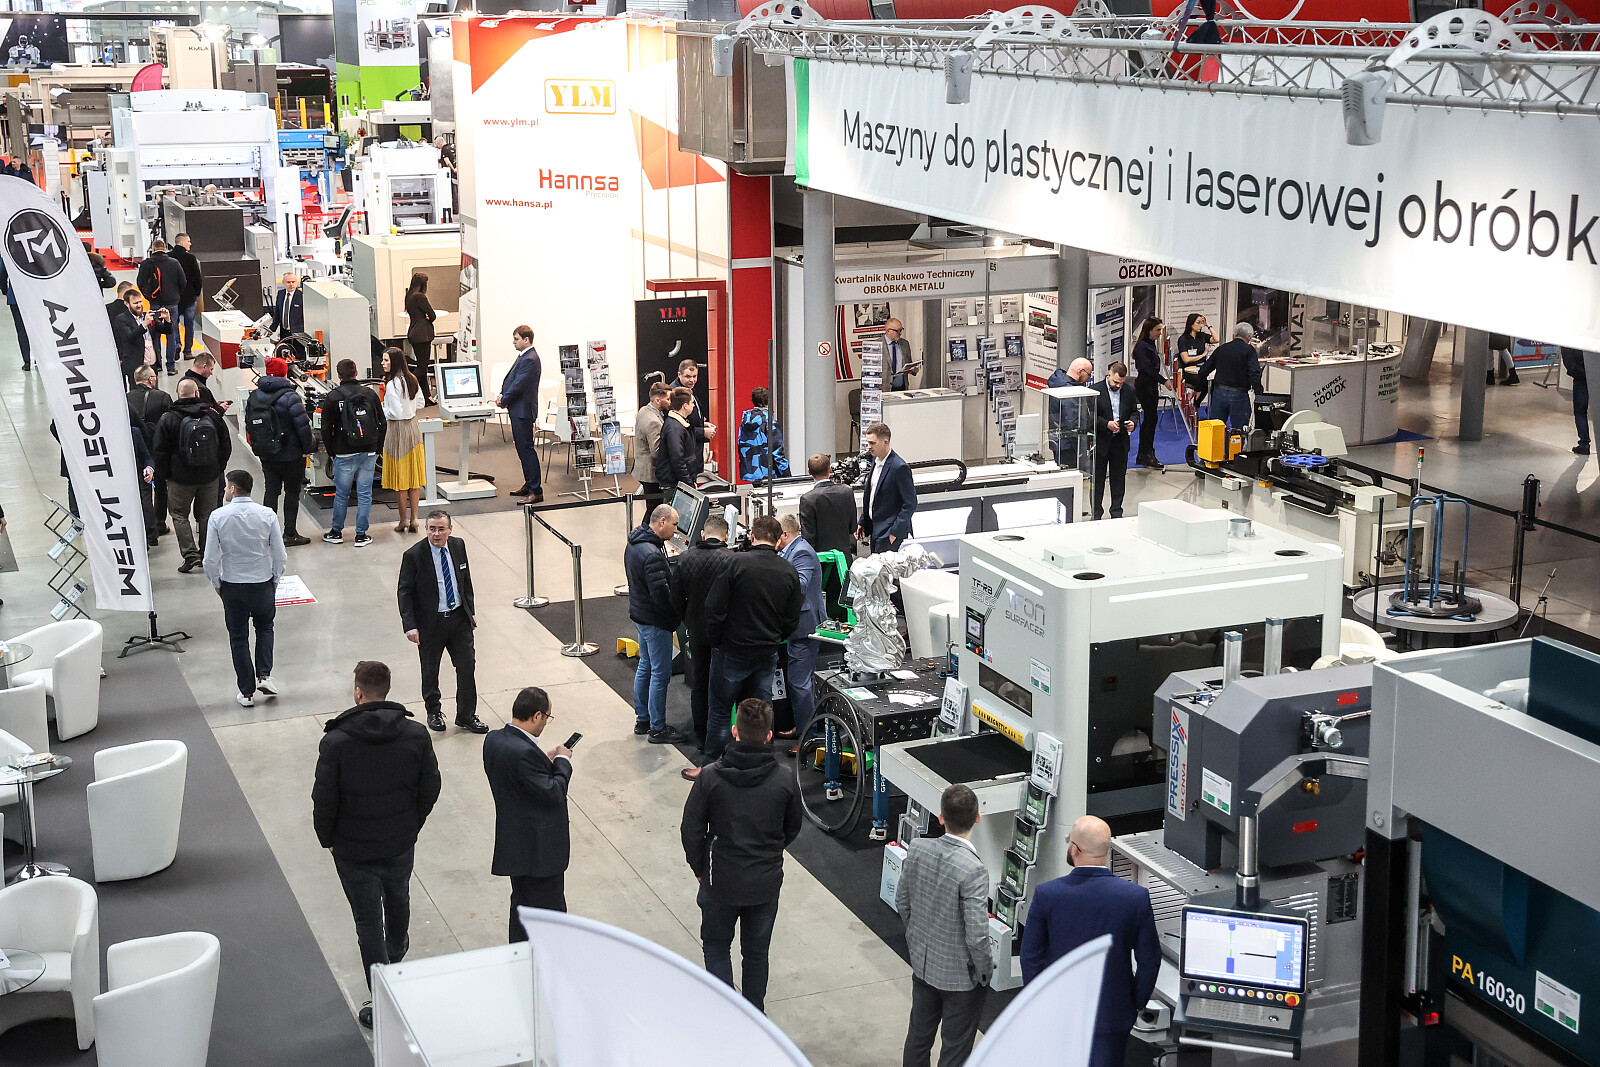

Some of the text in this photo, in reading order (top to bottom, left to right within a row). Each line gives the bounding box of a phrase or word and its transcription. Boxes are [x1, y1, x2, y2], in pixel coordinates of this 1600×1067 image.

[550, 85, 611, 108] YLM
[483, 118, 539, 128] www.ylm.pl
[539, 168, 619, 191] Hannsa
[843, 109, 1600, 265] Maszyny do plastycznej i laserowej obróbk
[585, 190, 619, 198] Precision
[485, 198, 553, 210] www.hansa.pl
[989, 262, 997, 272] E5
[1119, 264, 1173, 279] OBERON
[834, 269, 975, 285] Kwartalnik Naukowo Techniczny
[863, 281, 945, 295] OBRÓBKA METALU
[659, 307, 686, 319] YLM
[1322, 375, 1342, 392] KUPISZ
[1314, 382, 1346, 408] TOOLOX
[972, 577, 993, 595] TF-RB
[1005, 610, 1044, 638] SURFACER
[987, 714, 1008, 734] MAGNETIC
[1169, 719, 1184, 810] PRESSIX
[1452, 955, 1475, 985] PA
[1477, 971, 1526, 1014] 16030
